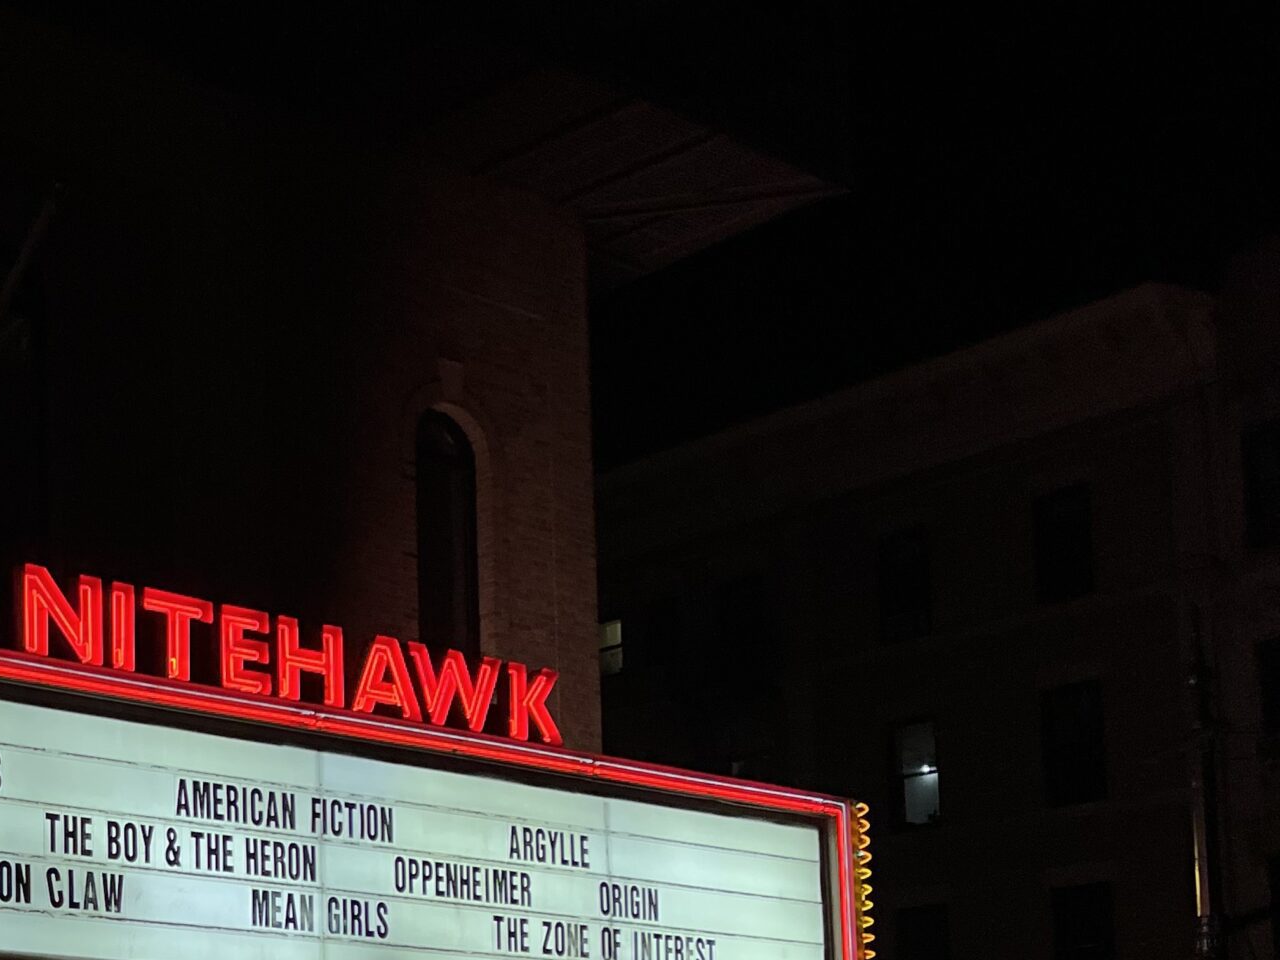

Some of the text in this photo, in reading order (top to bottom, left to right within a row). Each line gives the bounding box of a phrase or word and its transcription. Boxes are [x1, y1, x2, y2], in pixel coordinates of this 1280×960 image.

[24, 563, 563, 746] NITEHAWK
[176, 778, 394, 843] AMERICAN FICTION
[45, 812, 316, 882] THE BOY & THE HERON
[509, 825, 590, 869] ARGYLLE
[46, 867, 124, 913] CLAW
[394, 856, 532, 907] OPPENHEIMER
[599, 882, 659, 921] ORIGIN
[251, 889, 389, 939] MEAN GIRLS
[493, 915, 530, 952] THE
[542, 921, 589, 959] ZONE
